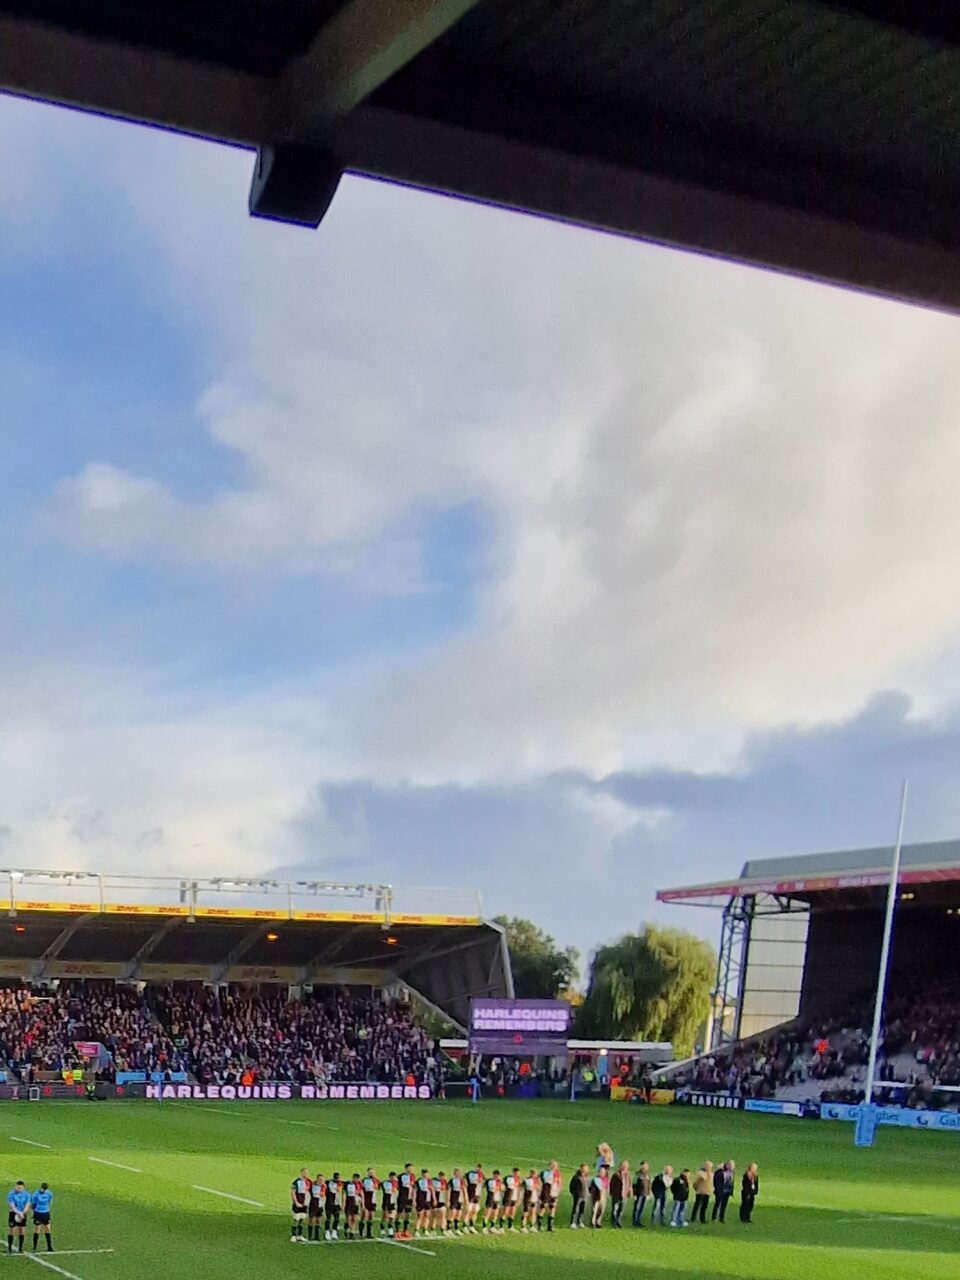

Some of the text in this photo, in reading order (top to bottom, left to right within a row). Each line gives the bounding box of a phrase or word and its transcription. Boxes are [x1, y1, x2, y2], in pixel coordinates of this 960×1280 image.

[473, 1008, 570, 1020] HARLEQUINS
[473, 1019, 567, 1031] REMEMBERS
[145, 1085, 431, 1099] HARLEQUINS REMEMBERS
